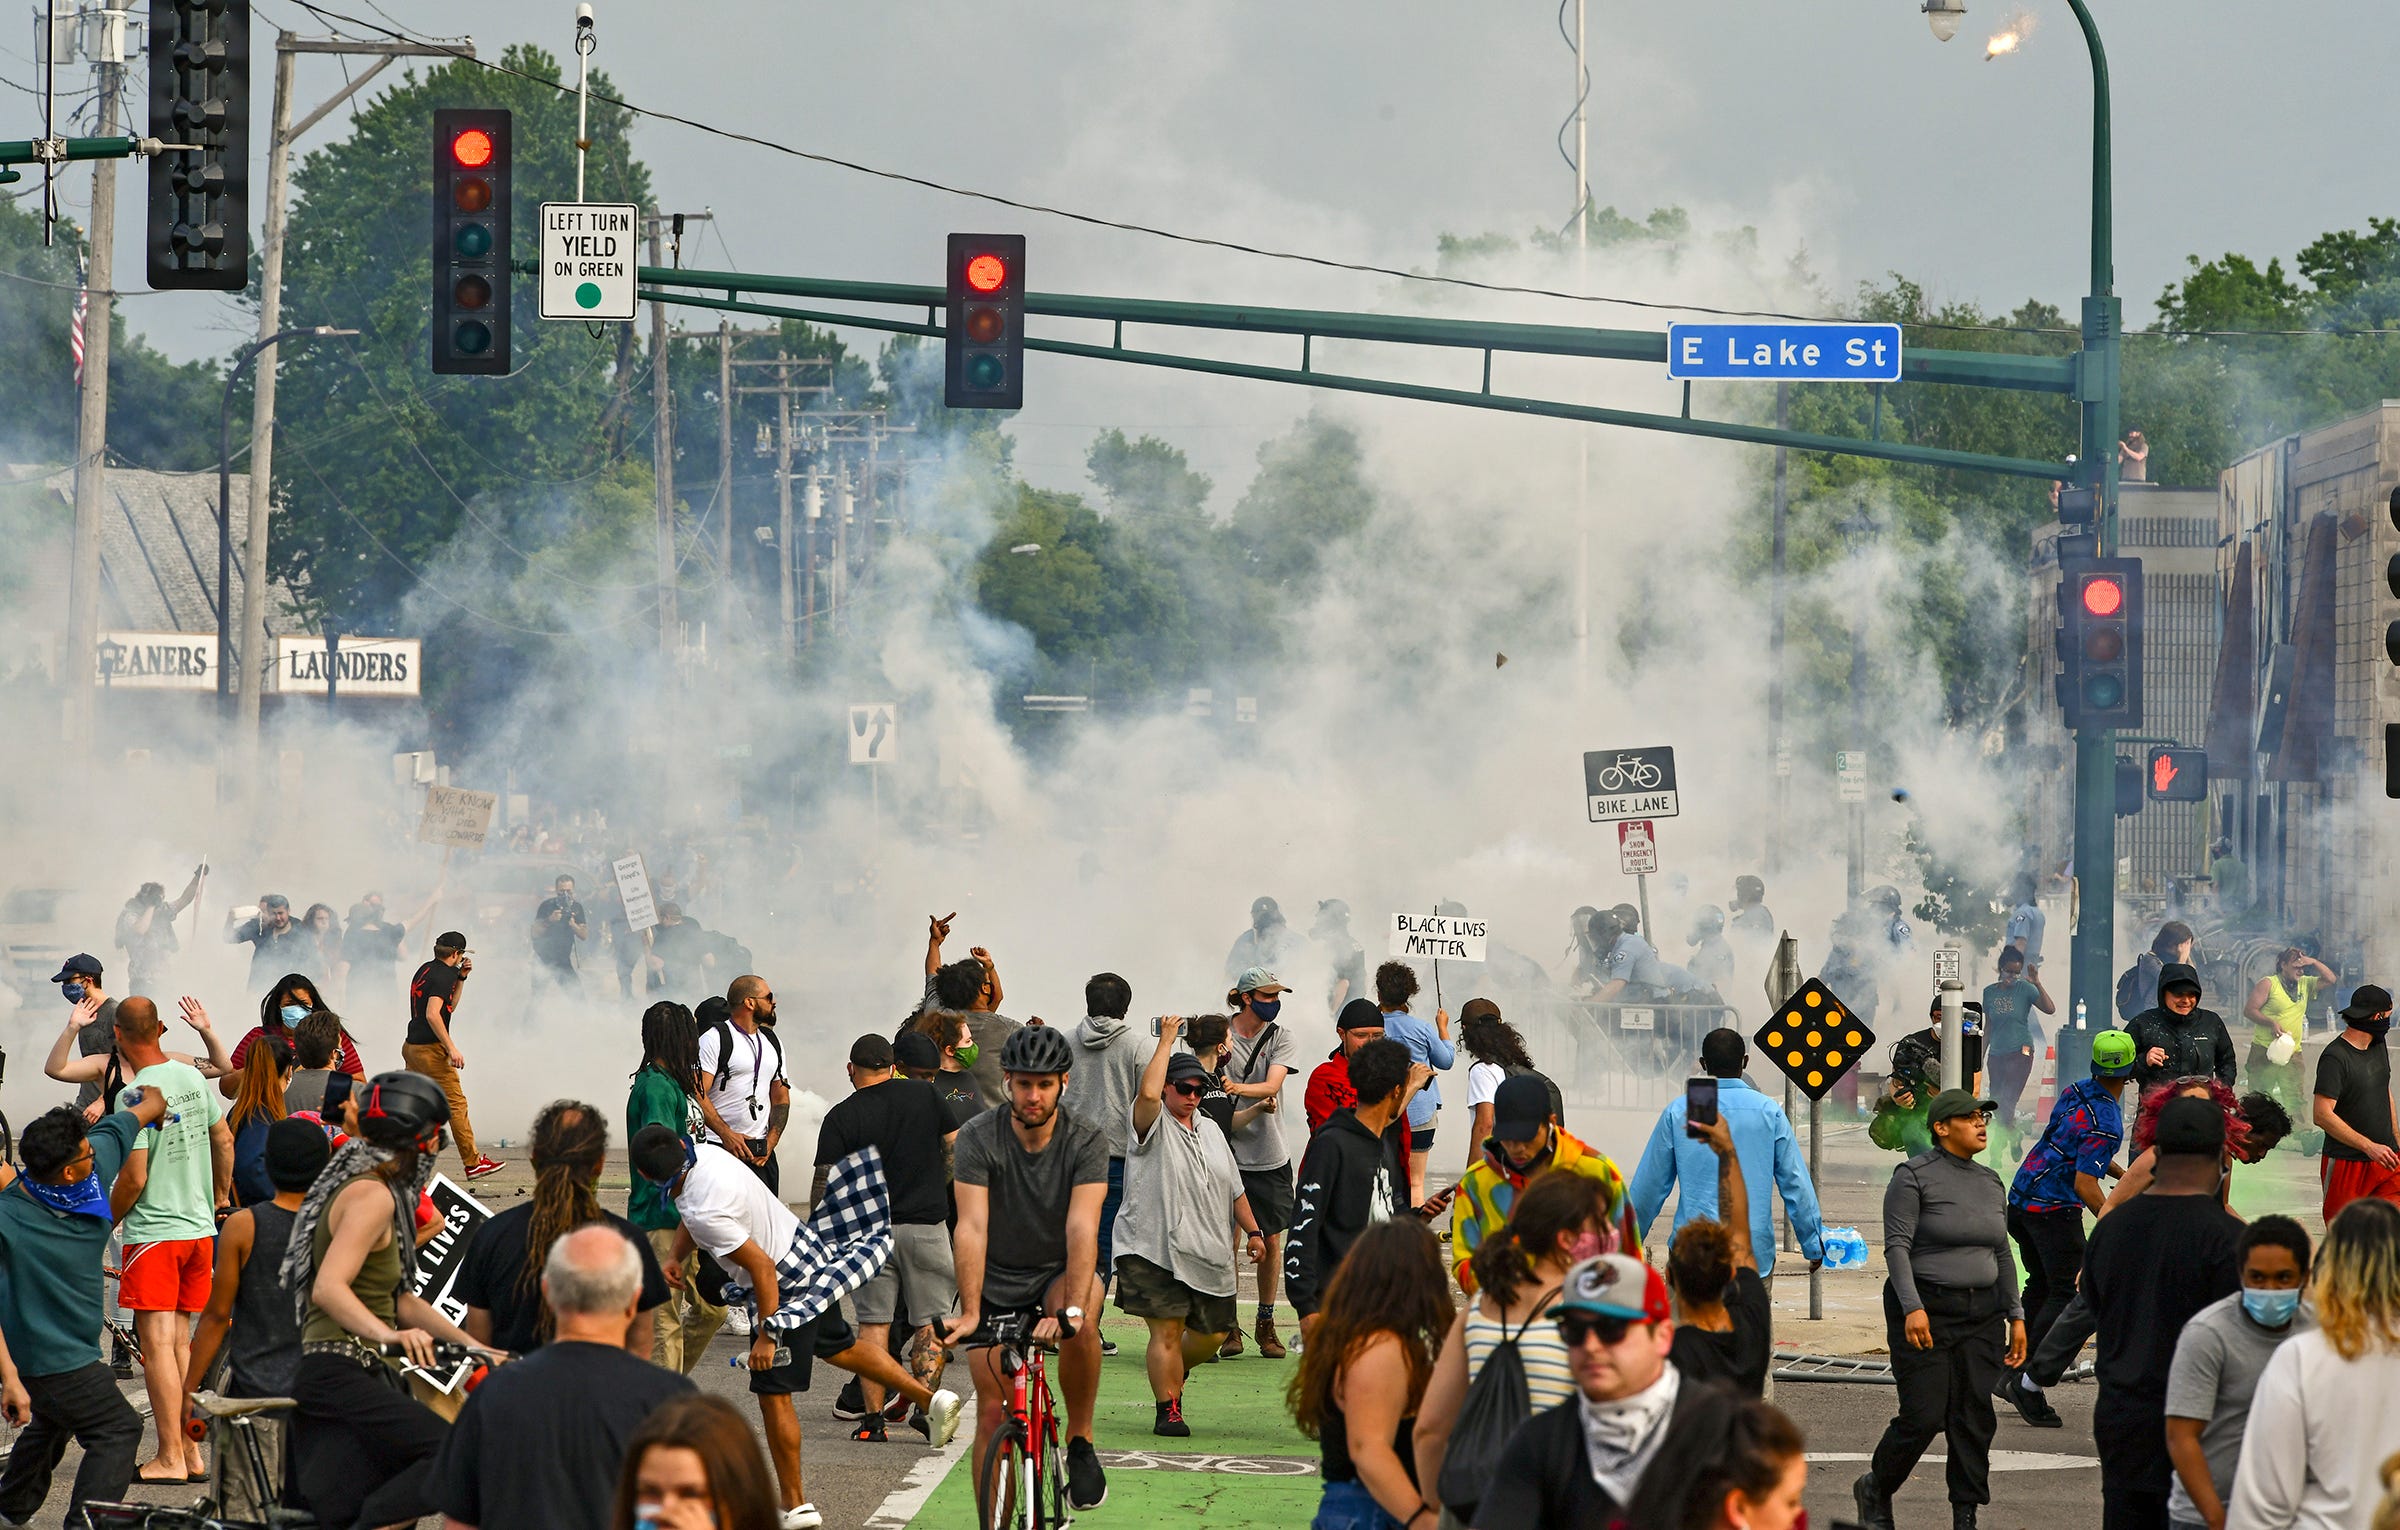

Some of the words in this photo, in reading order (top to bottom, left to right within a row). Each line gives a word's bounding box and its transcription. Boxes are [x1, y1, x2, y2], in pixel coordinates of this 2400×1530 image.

[550, 213, 583, 231] LEFT
[591, 213, 629, 231] TURN
[562, 236, 617, 257] YIELD
[554, 261, 573, 277] ON
[579, 262, 624, 277] GREEN
[1682, 337, 1704, 365] E
[1728, 338, 1821, 366] Lake
[1845, 338, 1887, 367] St
[98, 644, 207, 676] EANERS
[290, 650, 408, 682] LAUNDERS
[435, 790, 457, 805] WE
[459, 792, 495, 810] KNOW
[1597, 799, 1628, 814] BIKE
[1635, 797, 1669, 812] LANE
[1623, 849, 1653, 858] EMERGENCY
[1629, 840, 1645, 849] SNOW
[1630, 858, 1648, 866] ROUTE
[1397, 915, 1446, 934] BLACK
[1454, 921, 1486, 937] LIVES
[1405, 935, 1467, 958] MATTER
[422, 1203, 471, 1266] LIVES
